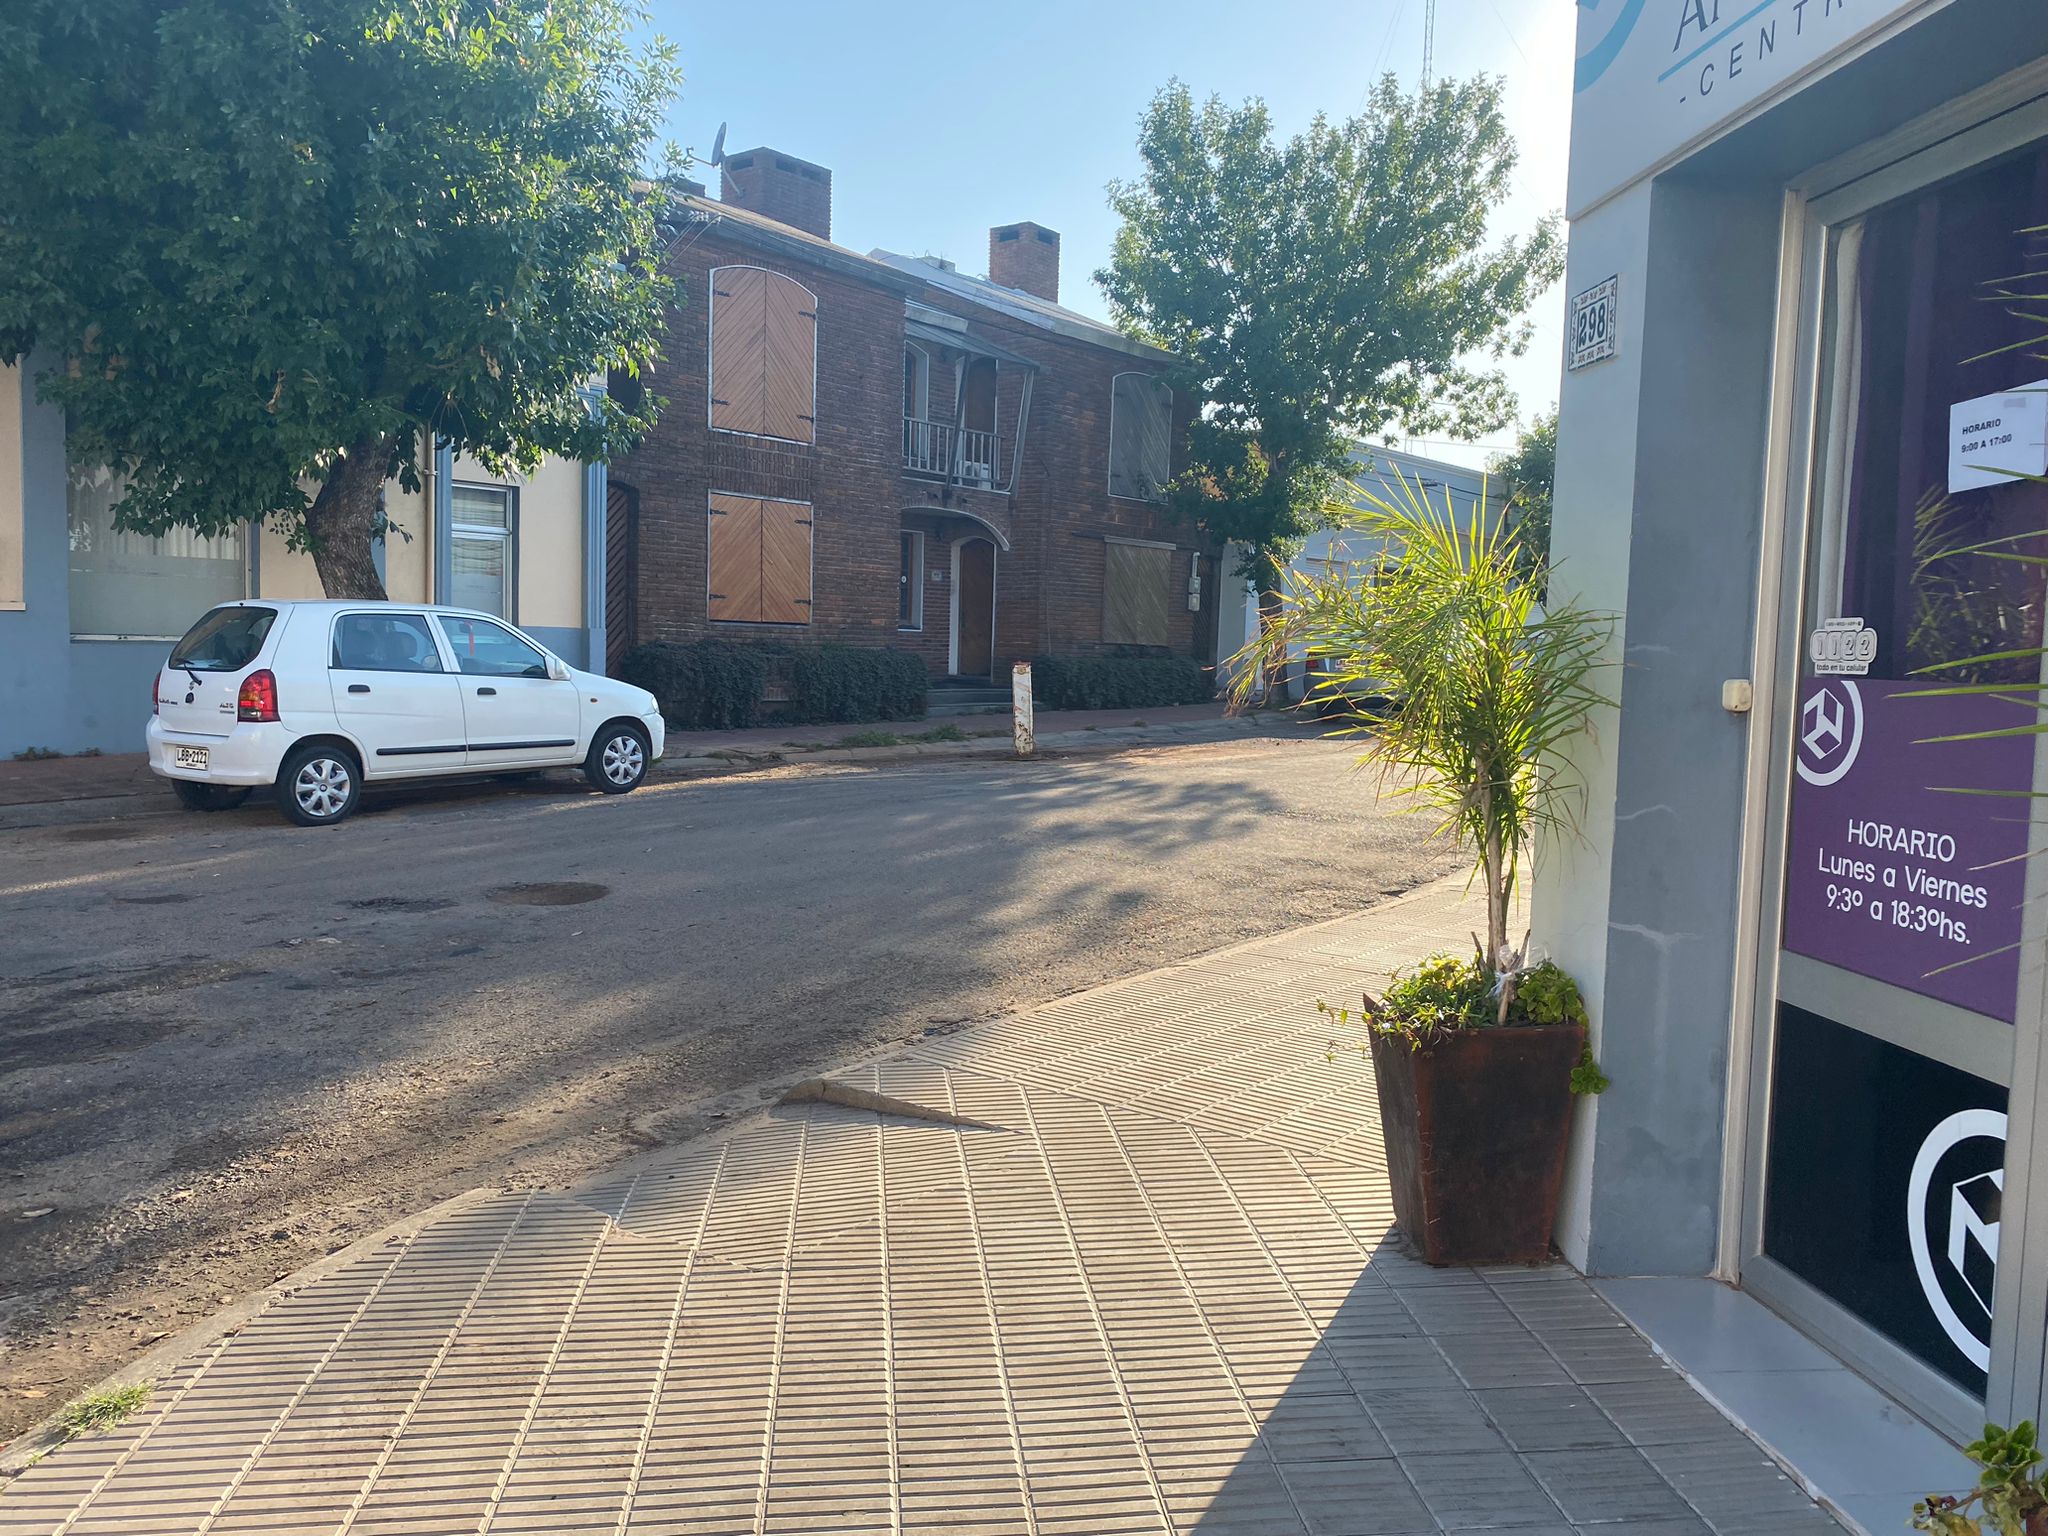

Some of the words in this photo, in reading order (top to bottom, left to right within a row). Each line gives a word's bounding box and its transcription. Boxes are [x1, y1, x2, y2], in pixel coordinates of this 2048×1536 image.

[1579, 302, 1606, 348] 298
[1962, 418, 2001, 435] HORARIO
[1961, 441, 1979, 453] 9:00
[1980, 440, 1987, 449] A
[1989, 433, 2013, 447] 17:00
[1816, 635, 1870, 656] 1122
[1848, 818, 1956, 863] HORARIO
[1818, 847, 1876, 883] Lunes
[1883, 866, 1896, 888] a
[1905, 865, 1988, 909] Viernes
[1870, 900, 1883, 921] a
